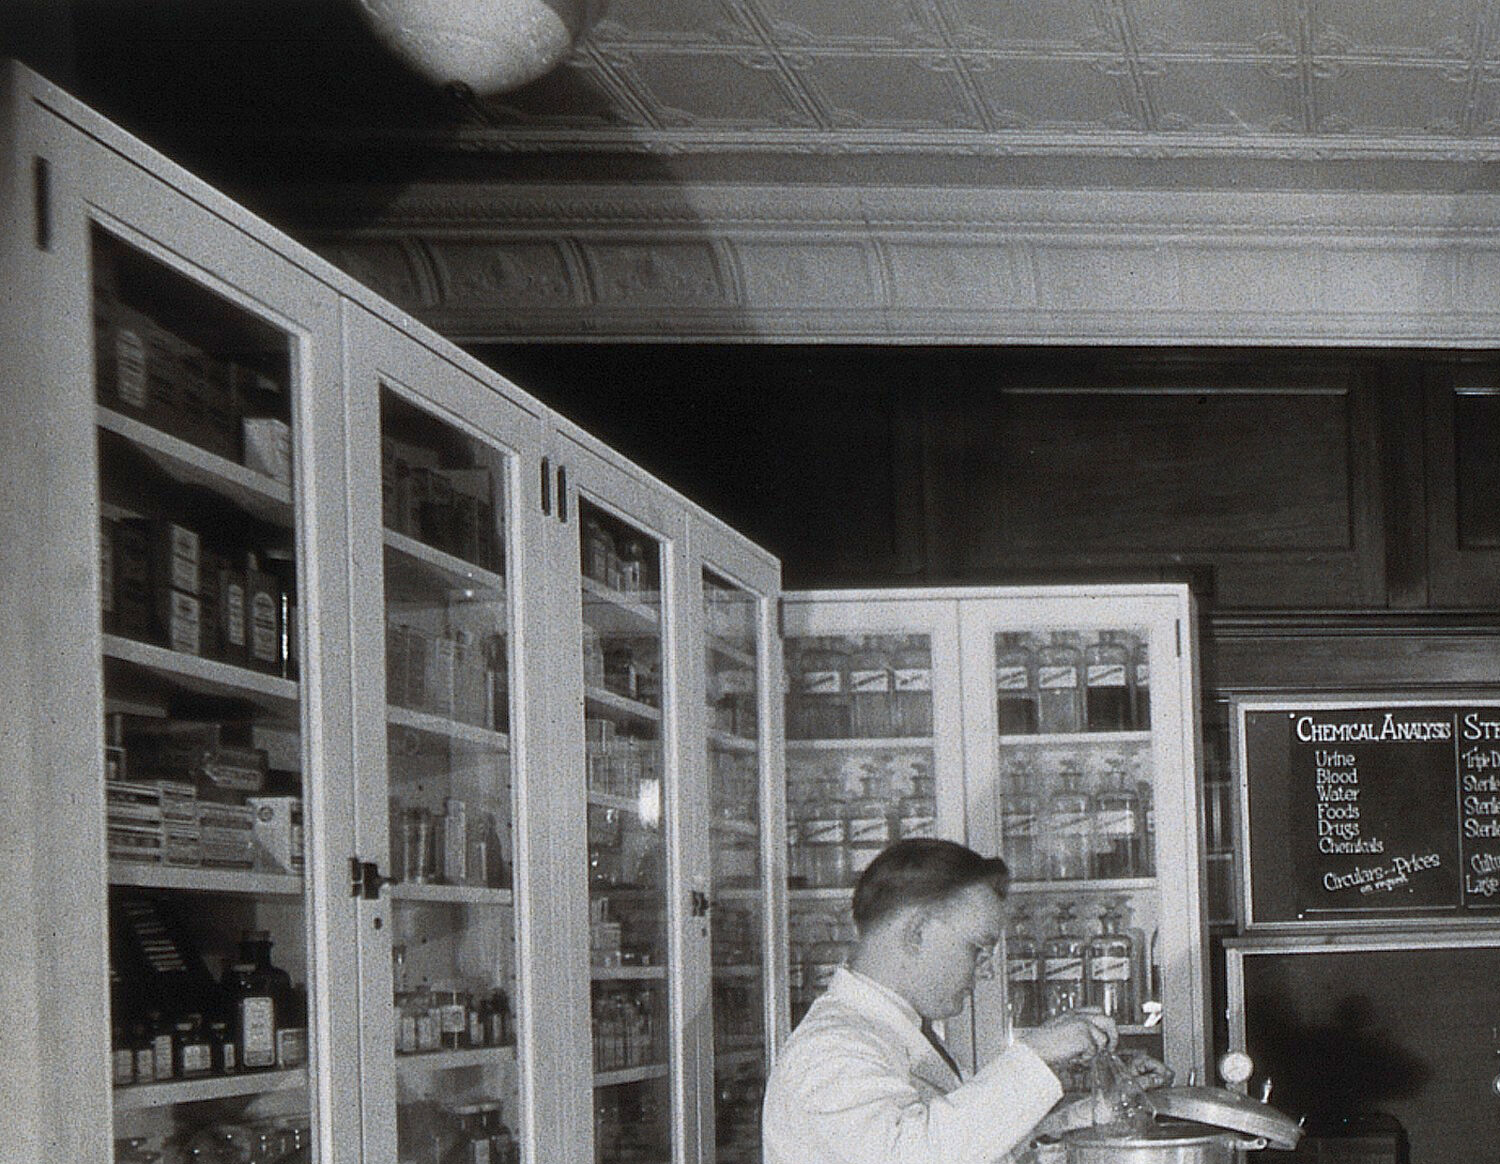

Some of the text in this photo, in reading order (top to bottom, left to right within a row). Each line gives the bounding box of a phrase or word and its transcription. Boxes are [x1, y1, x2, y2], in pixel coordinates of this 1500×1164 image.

[1297, 713, 1451, 742] CHEMICAL ANALYSIS
[1315, 750, 1356, 767] Urine
[1316, 768, 1359, 784] Blood
[1316, 785, 1360, 802] Water
[1317, 803, 1360, 820] Foods
[1317, 819, 1360, 840] Drugs
[1318, 836, 1384, 854] Chemicals
[1323, 853, 1441, 891] Circulars Prices
[1466, 874, 1500, 897] Large
